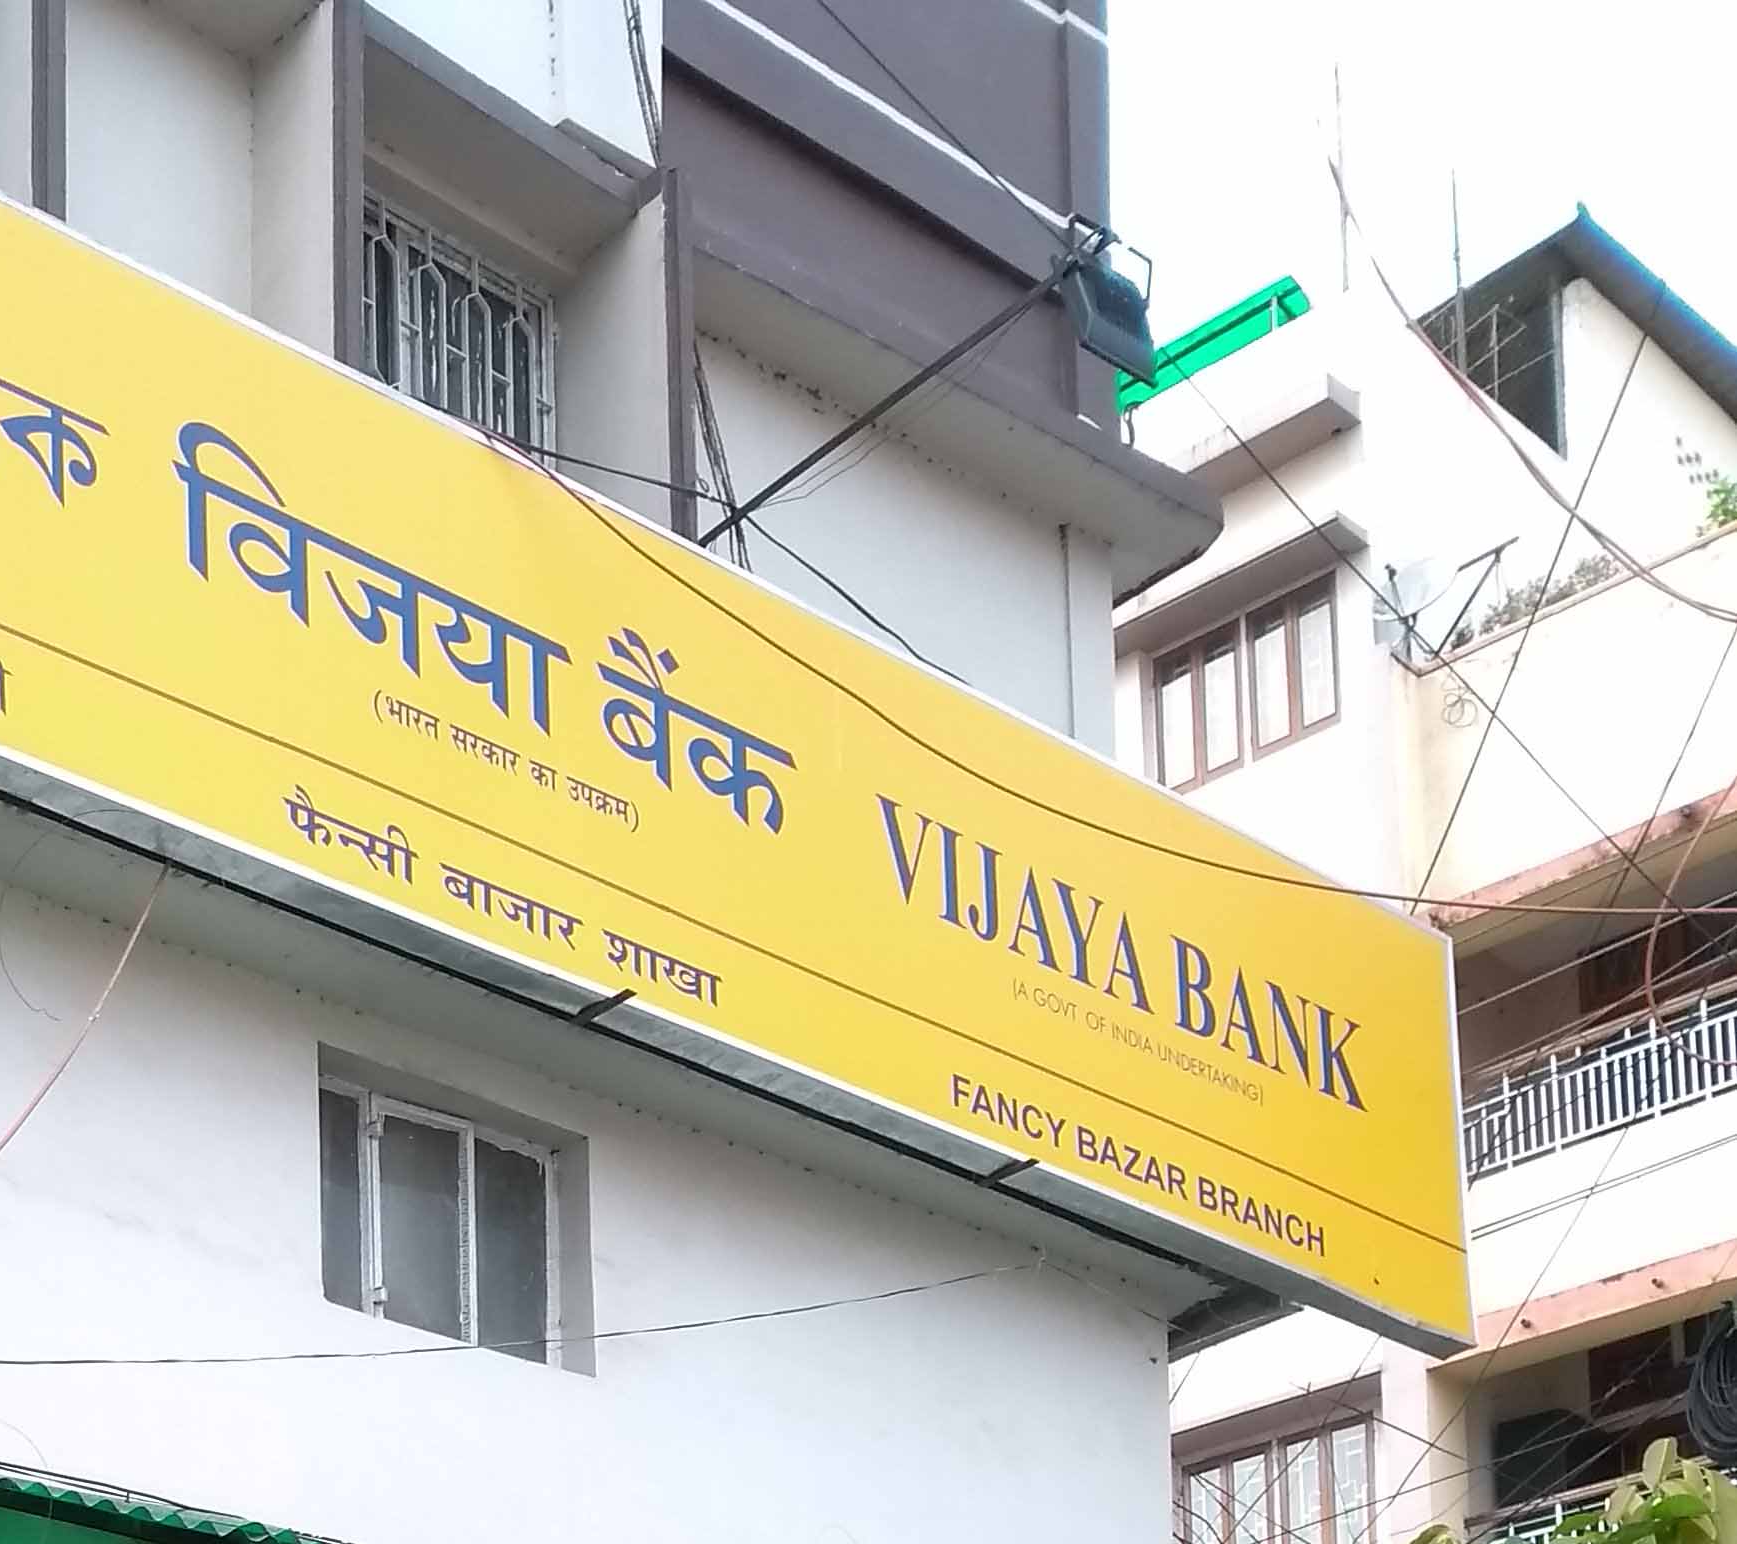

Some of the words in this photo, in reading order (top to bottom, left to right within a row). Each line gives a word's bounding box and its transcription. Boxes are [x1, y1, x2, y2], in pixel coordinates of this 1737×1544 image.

[172, 420, 572, 738] विजया
[597, 627, 797, 837] बैंक
[373, 689, 440, 740] (भारत
[449, 723, 521, 776] सरकार
[529, 759, 558, 791] का
[566, 776, 640, 833] उपक्रम)
[282, 784, 419, 886] फैन्सी
[439, 862, 584, 950] बाजार
[602, 928, 723, 1007] शाखा
[875, 793, 1156, 1016] VIJAYA
[1169, 934, 1369, 1113] BANK
[1086, 1011, 1108, 1033] OF
[1111, 1022, 1154, 1053] INDIA
[1157, 1041, 1264, 1106] UNDERTAKING)
[950, 1073, 1067, 1148] FANCY
[1077, 1128, 1189, 1201] BAZAR
[1198, 1175, 1326, 1257] BRANCH
